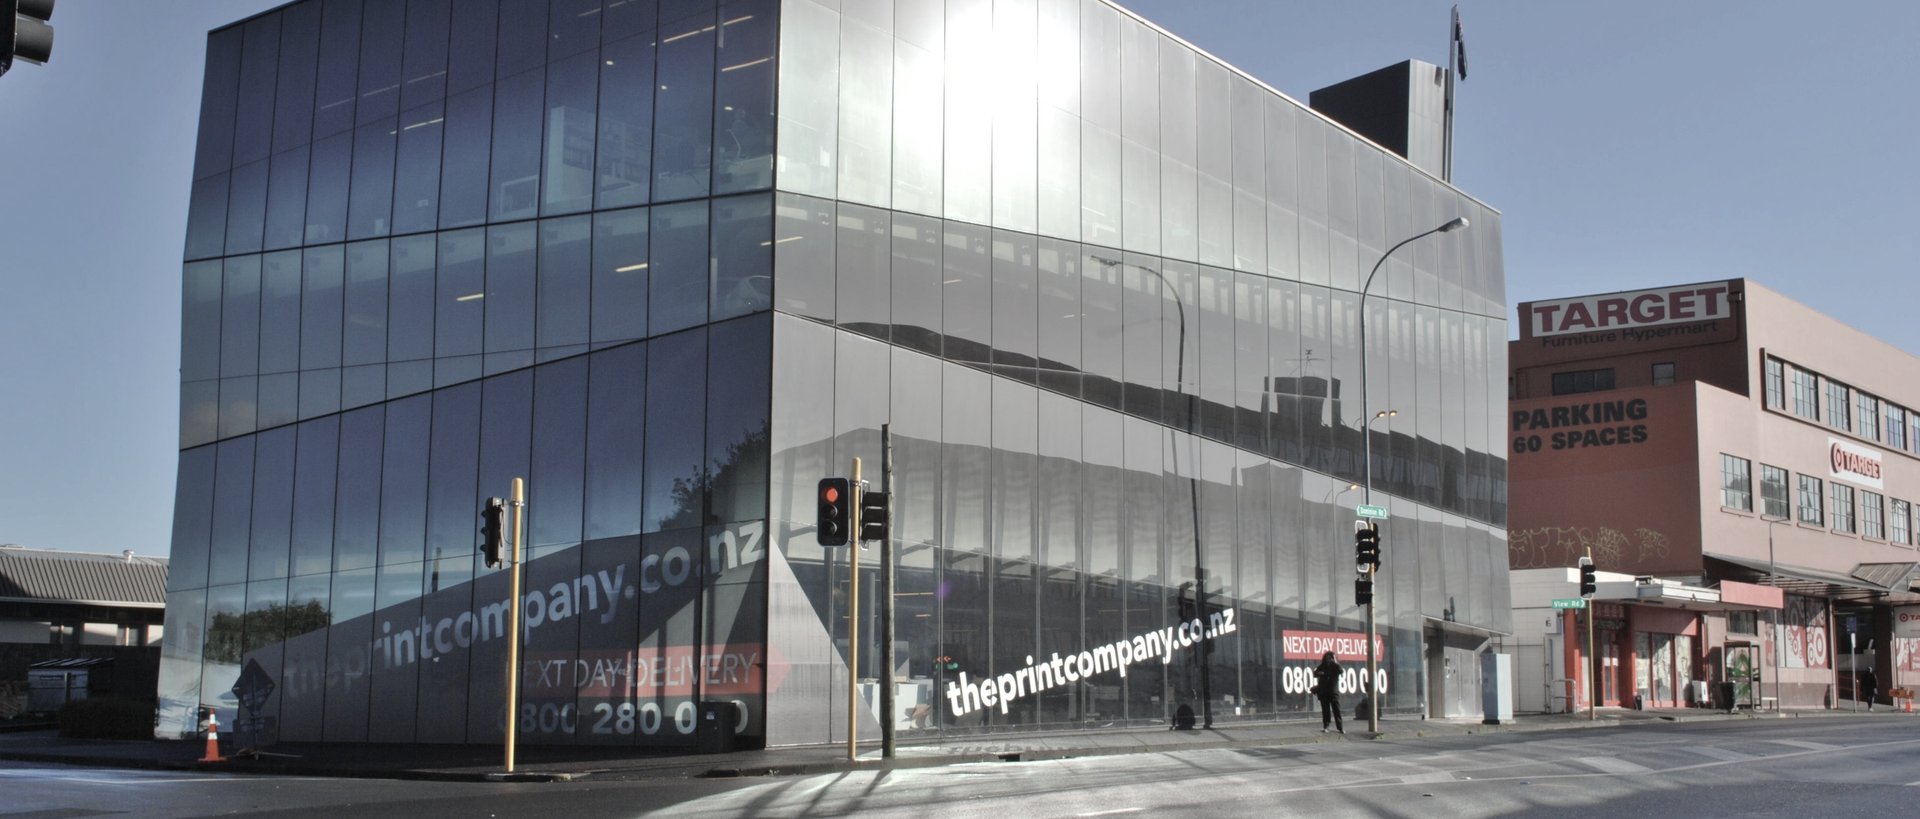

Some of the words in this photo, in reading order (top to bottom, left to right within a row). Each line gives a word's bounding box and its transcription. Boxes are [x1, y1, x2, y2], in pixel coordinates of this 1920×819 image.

[1533, 286, 1727, 333] TARGET
[1542, 331, 1617, 348] Furniture
[1622, 320, 1719, 342] Hypermart
[1512, 399, 1648, 431] PARKING
[1513, 435, 1542, 454] 60
[1551, 424, 1648, 450] SPACES
[947, 607, 1237, 717] theprintcompany.co.nz
[1283, 636, 1312, 654] NEXT
[1314, 637, 1335, 654] DAY
[1337, 638, 1381, 656] DELIVEY
[574, 657, 623, 688] DAY
[630, 651, 758, 687] DELIVERY
[591, 701, 662, 736] 280
[674, 699, 750, 735] 00
